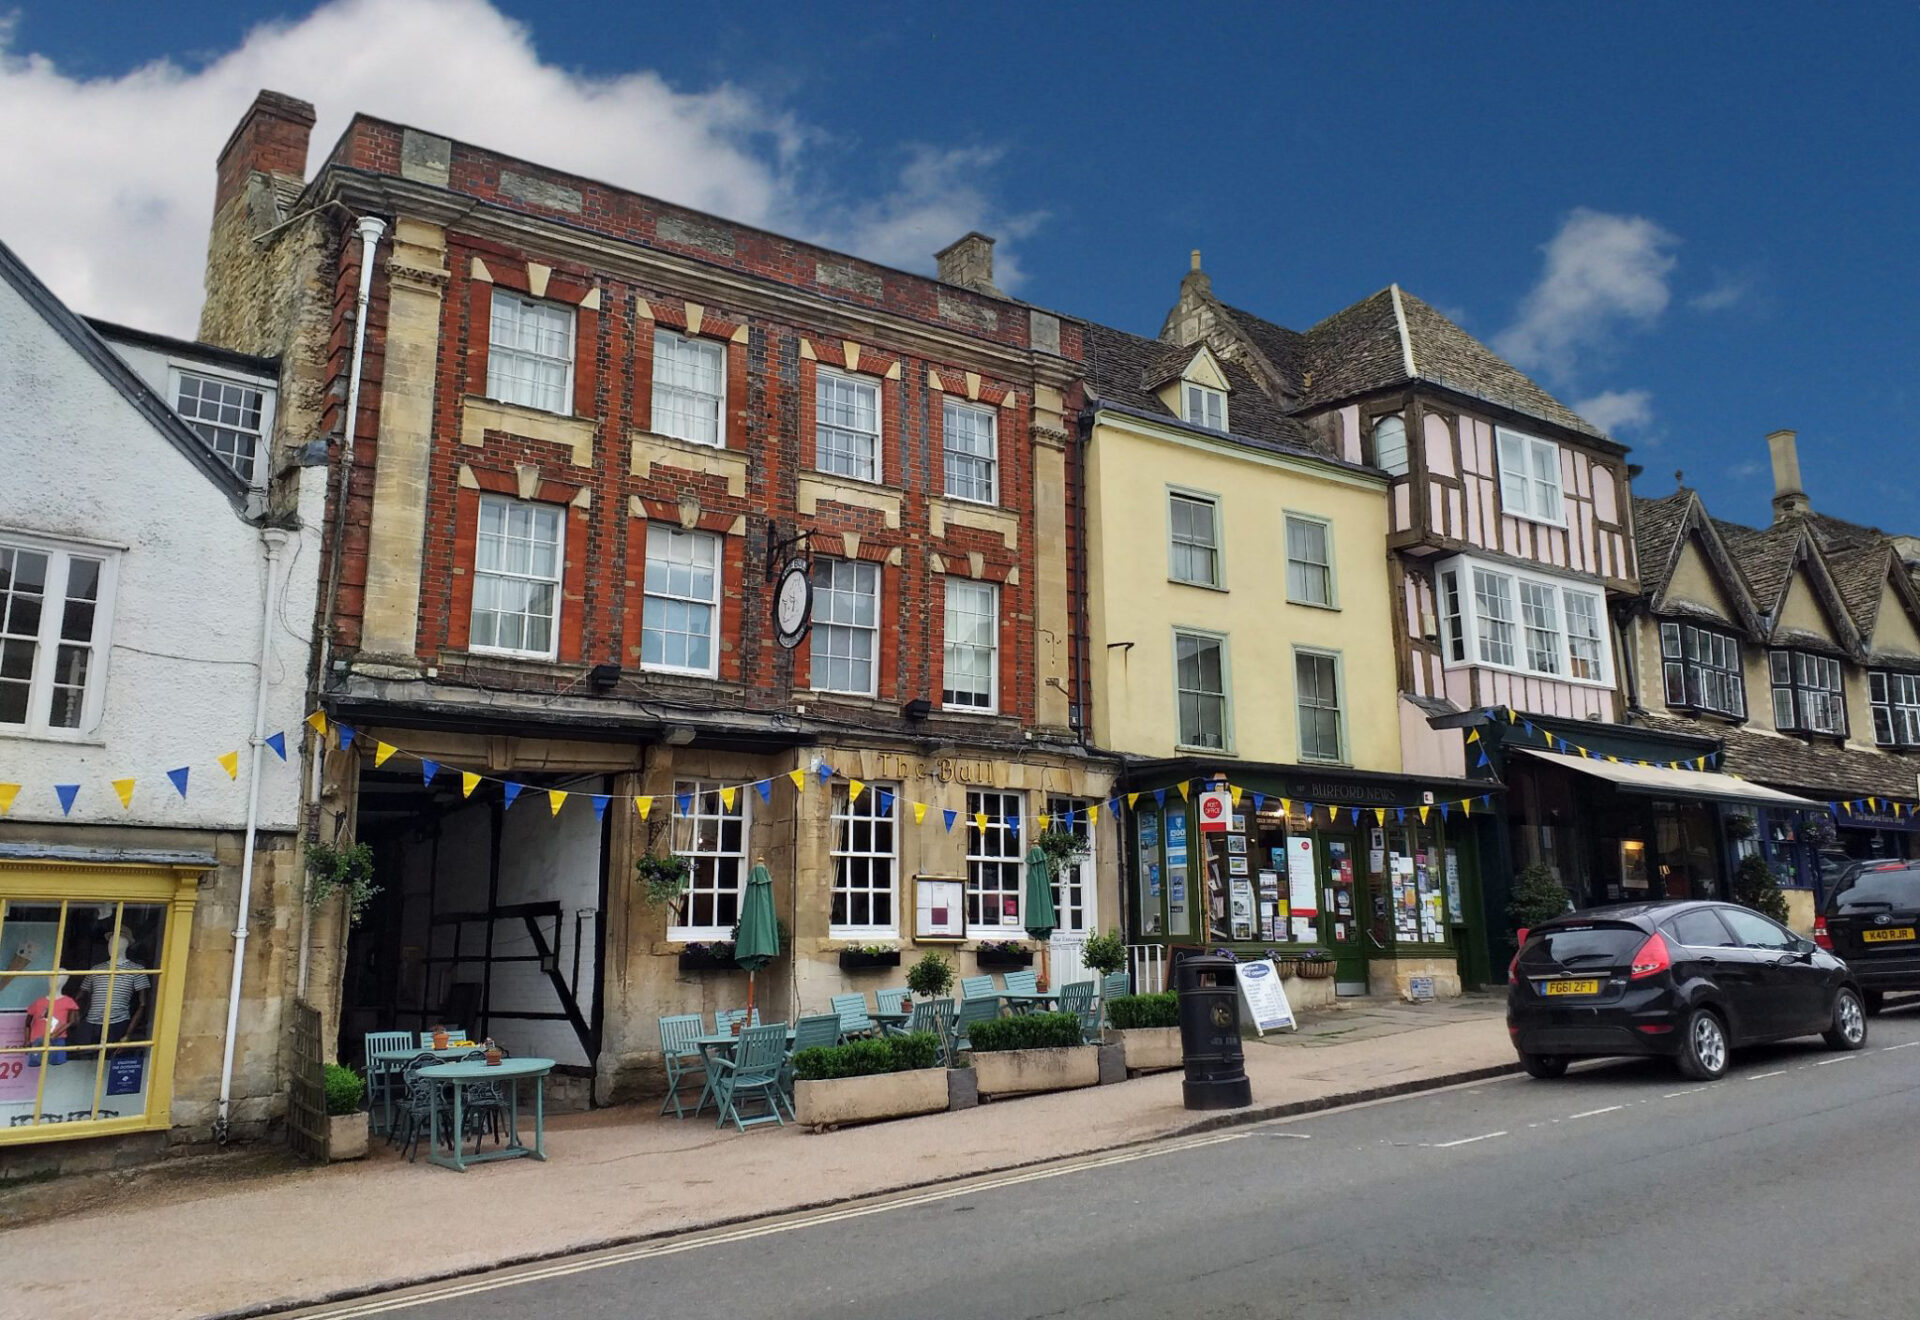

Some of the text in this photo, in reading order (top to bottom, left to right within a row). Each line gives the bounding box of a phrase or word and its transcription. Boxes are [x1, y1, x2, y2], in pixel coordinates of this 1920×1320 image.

[877, 755, 993, 783] The Bull
[1312, 783, 1364, 799] BURFORD
[1366, 787, 1396, 800] NEWS
[1550, 981, 1593, 993] FG61 ZFT
[0, 1061, 23, 1080] 29
